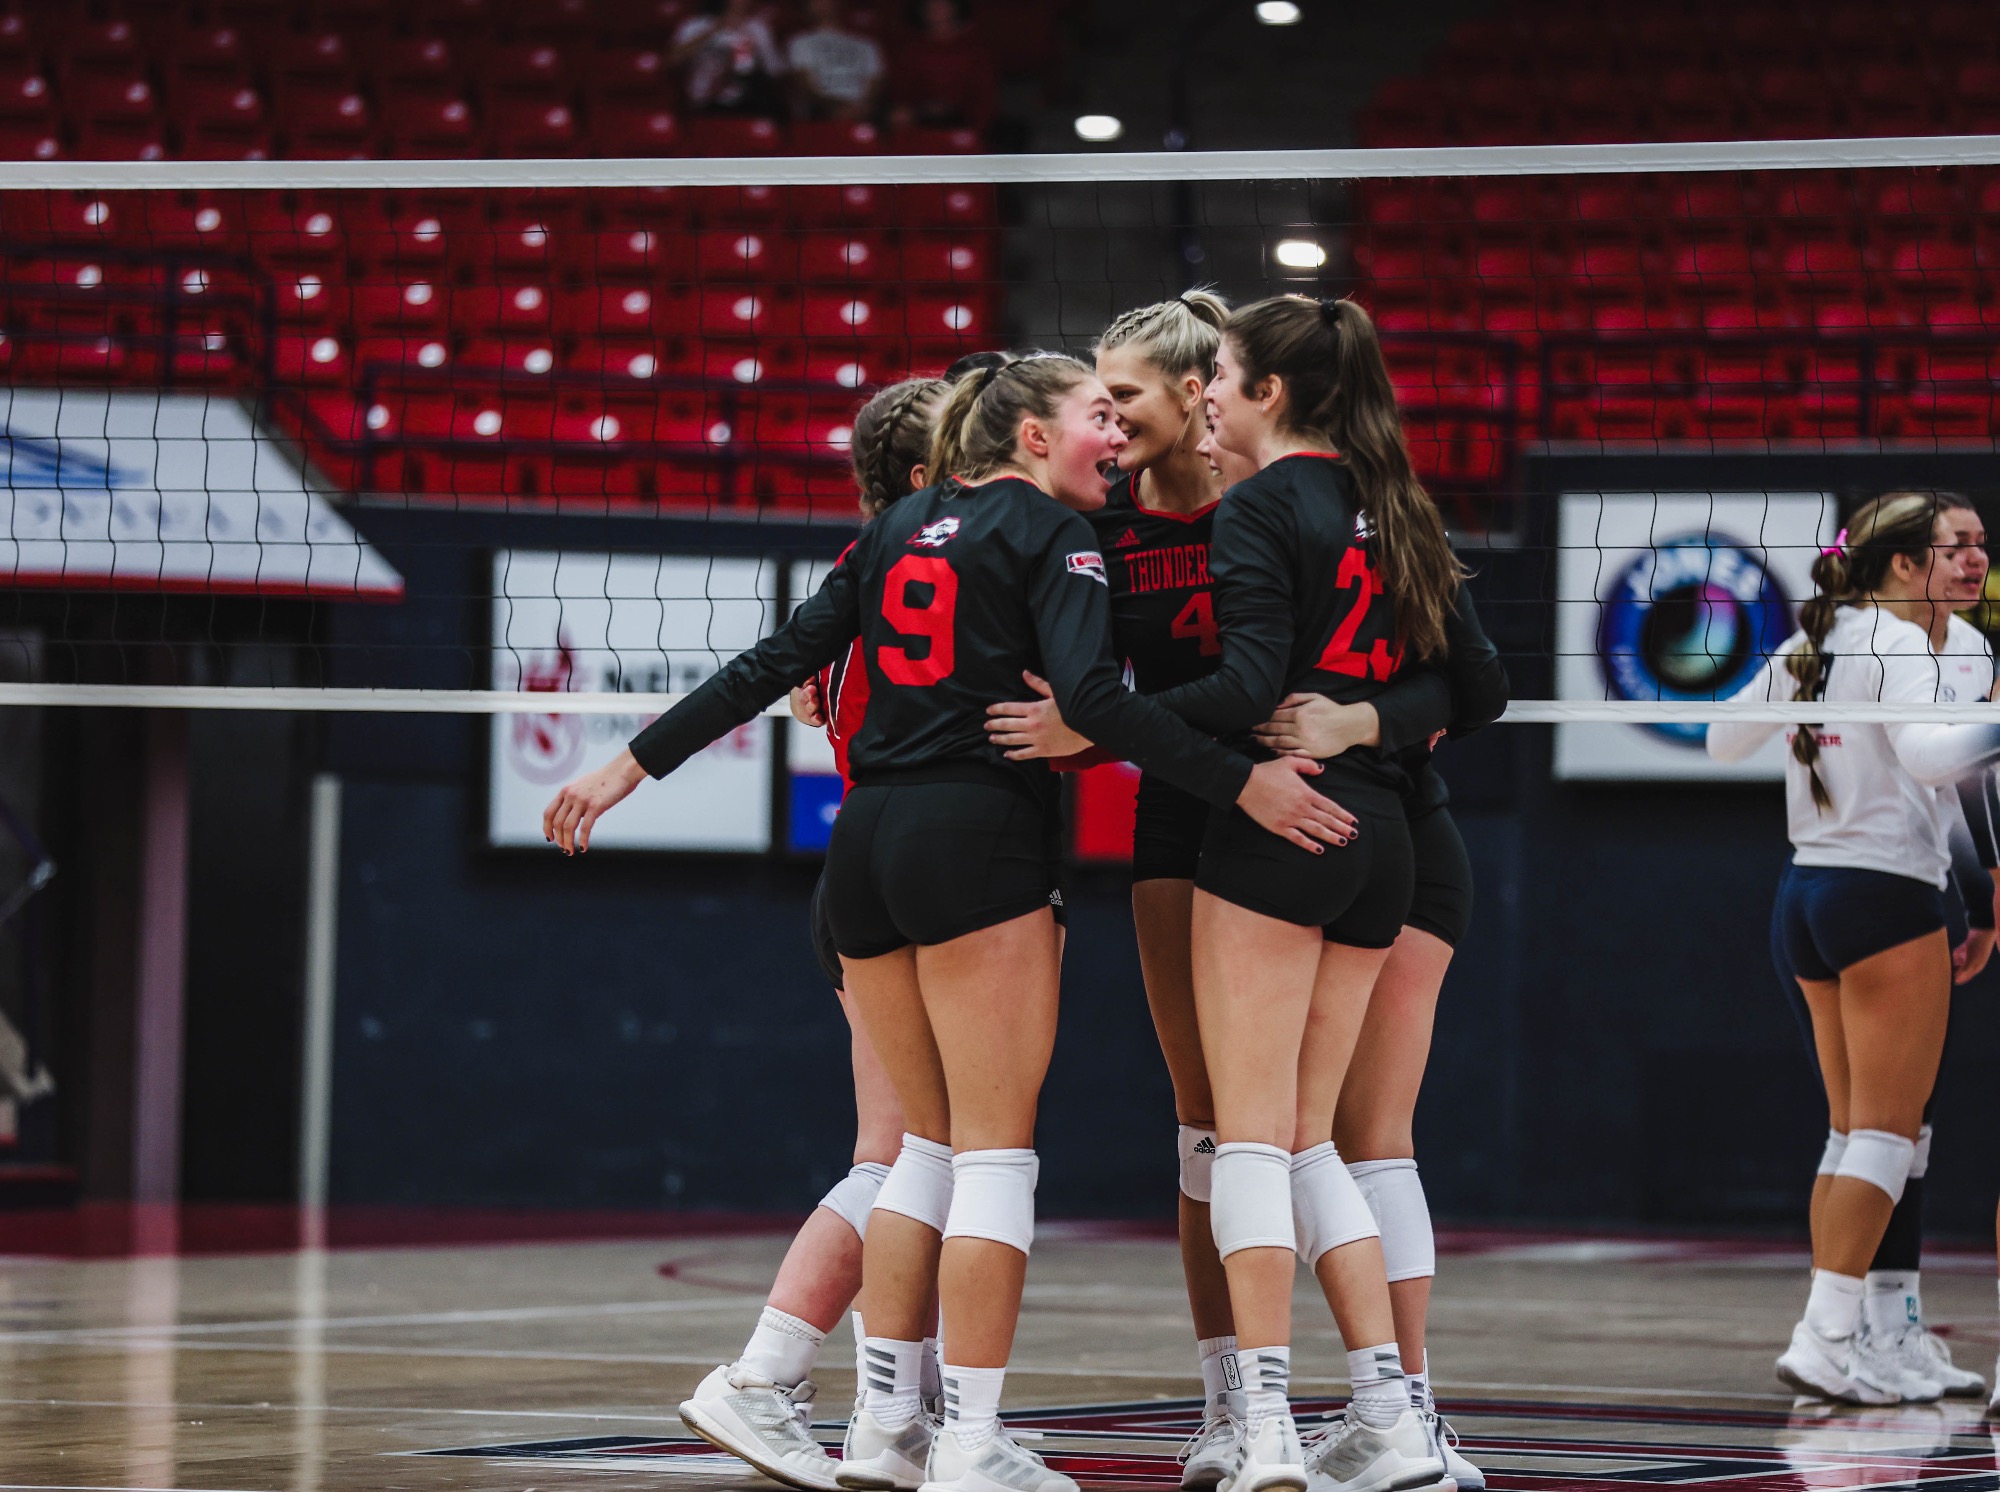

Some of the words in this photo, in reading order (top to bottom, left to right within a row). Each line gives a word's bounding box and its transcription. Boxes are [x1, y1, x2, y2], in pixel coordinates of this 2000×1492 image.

[1124, 543, 1214, 593] THUNDER
[878, 554, 958, 687] 9
[1171, 591, 1224, 657] 4
[1193, 1146, 1216, 1154] adida
